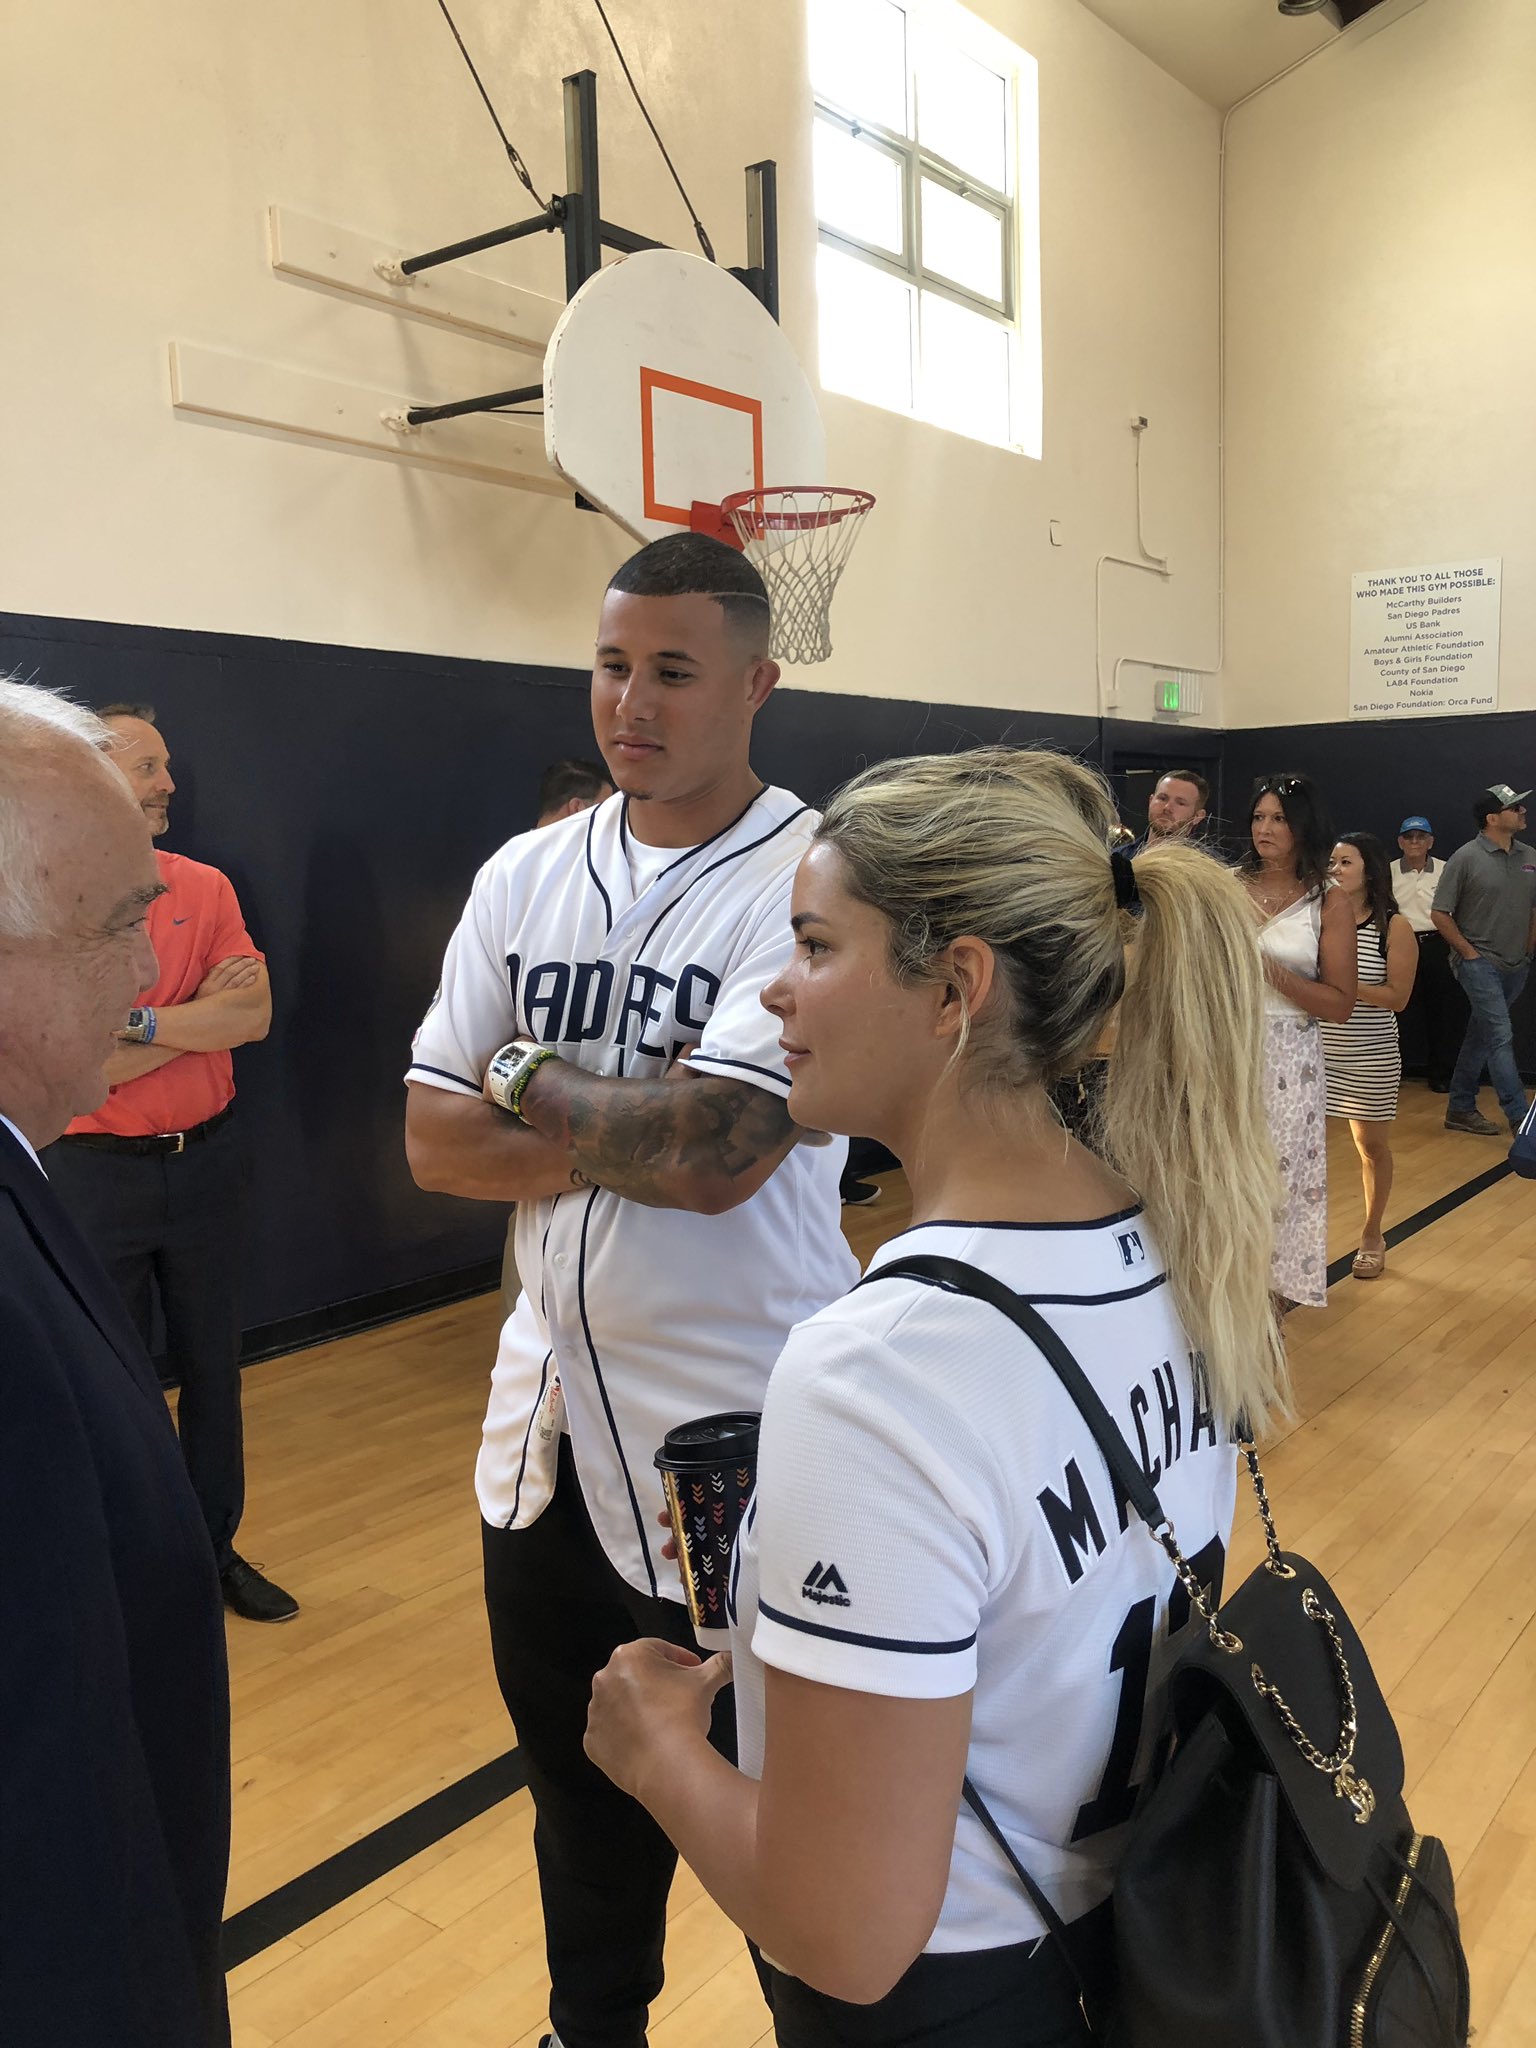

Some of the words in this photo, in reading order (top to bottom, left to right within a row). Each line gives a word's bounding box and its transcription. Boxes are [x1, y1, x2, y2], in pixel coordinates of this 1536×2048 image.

[1368, 577, 1397, 587] THANK
[1399, 576, 1418, 584] YOU
[1420, 573, 1432, 582] TO
[1434, 571, 1451, 580] ALL
[1454, 568, 1484, 578] THOSE
[1356, 589, 1378, 599] WHO
[1379, 586, 1404, 596] MADE
[1406, 585, 1426, 594] THIS
[1428, 583, 1447, 591] GYM
[1449, 577, 1496, 590] POSSIBLE:
[1386, 599, 1425, 609] McCarthy
[1427, 596, 1462, 605] Builders
[1387, 612, 1403, 620] San
[1404, 610, 1429, 619] Diego
[1431, 607, 1461, 616] Padres
[1406, 621, 1418, 630] US
[1420, 620, 1441, 629] Bank
[1384, 634, 1412, 643] Alumni
[1414, 630, 1463, 640] Association
[1363, 647, 1399, 655] Amateur
[1400, 643, 1433, 653] Athletic
[1435, 640, 1484, 650] Foundation
[1373, 657, 1394, 666] Boys
[1395, 656, 1402, 664] &
[1403, 655, 1422, 664] Girls
[1424, 652, 1473, 662] Foundation
[1380, 668, 1409, 677] County
[1422, 666, 1438, 674] San
[1440, 664, 1465, 673] Diego
[1386, 679, 1408, 687] LA84
[1410, 676, 1458, 686] Foundation
[1409, 689, 1434, 697] Nokia
[1370, 702, 1394, 711] Diego
[1396, 699, 1446, 709] Foundation:
[1447, 698, 1468, 706] Orca
[1470, 696, 1493, 705] Fund
[506, 952, 721, 1059] ADRES
[802, 1587, 850, 1606] Majestic
